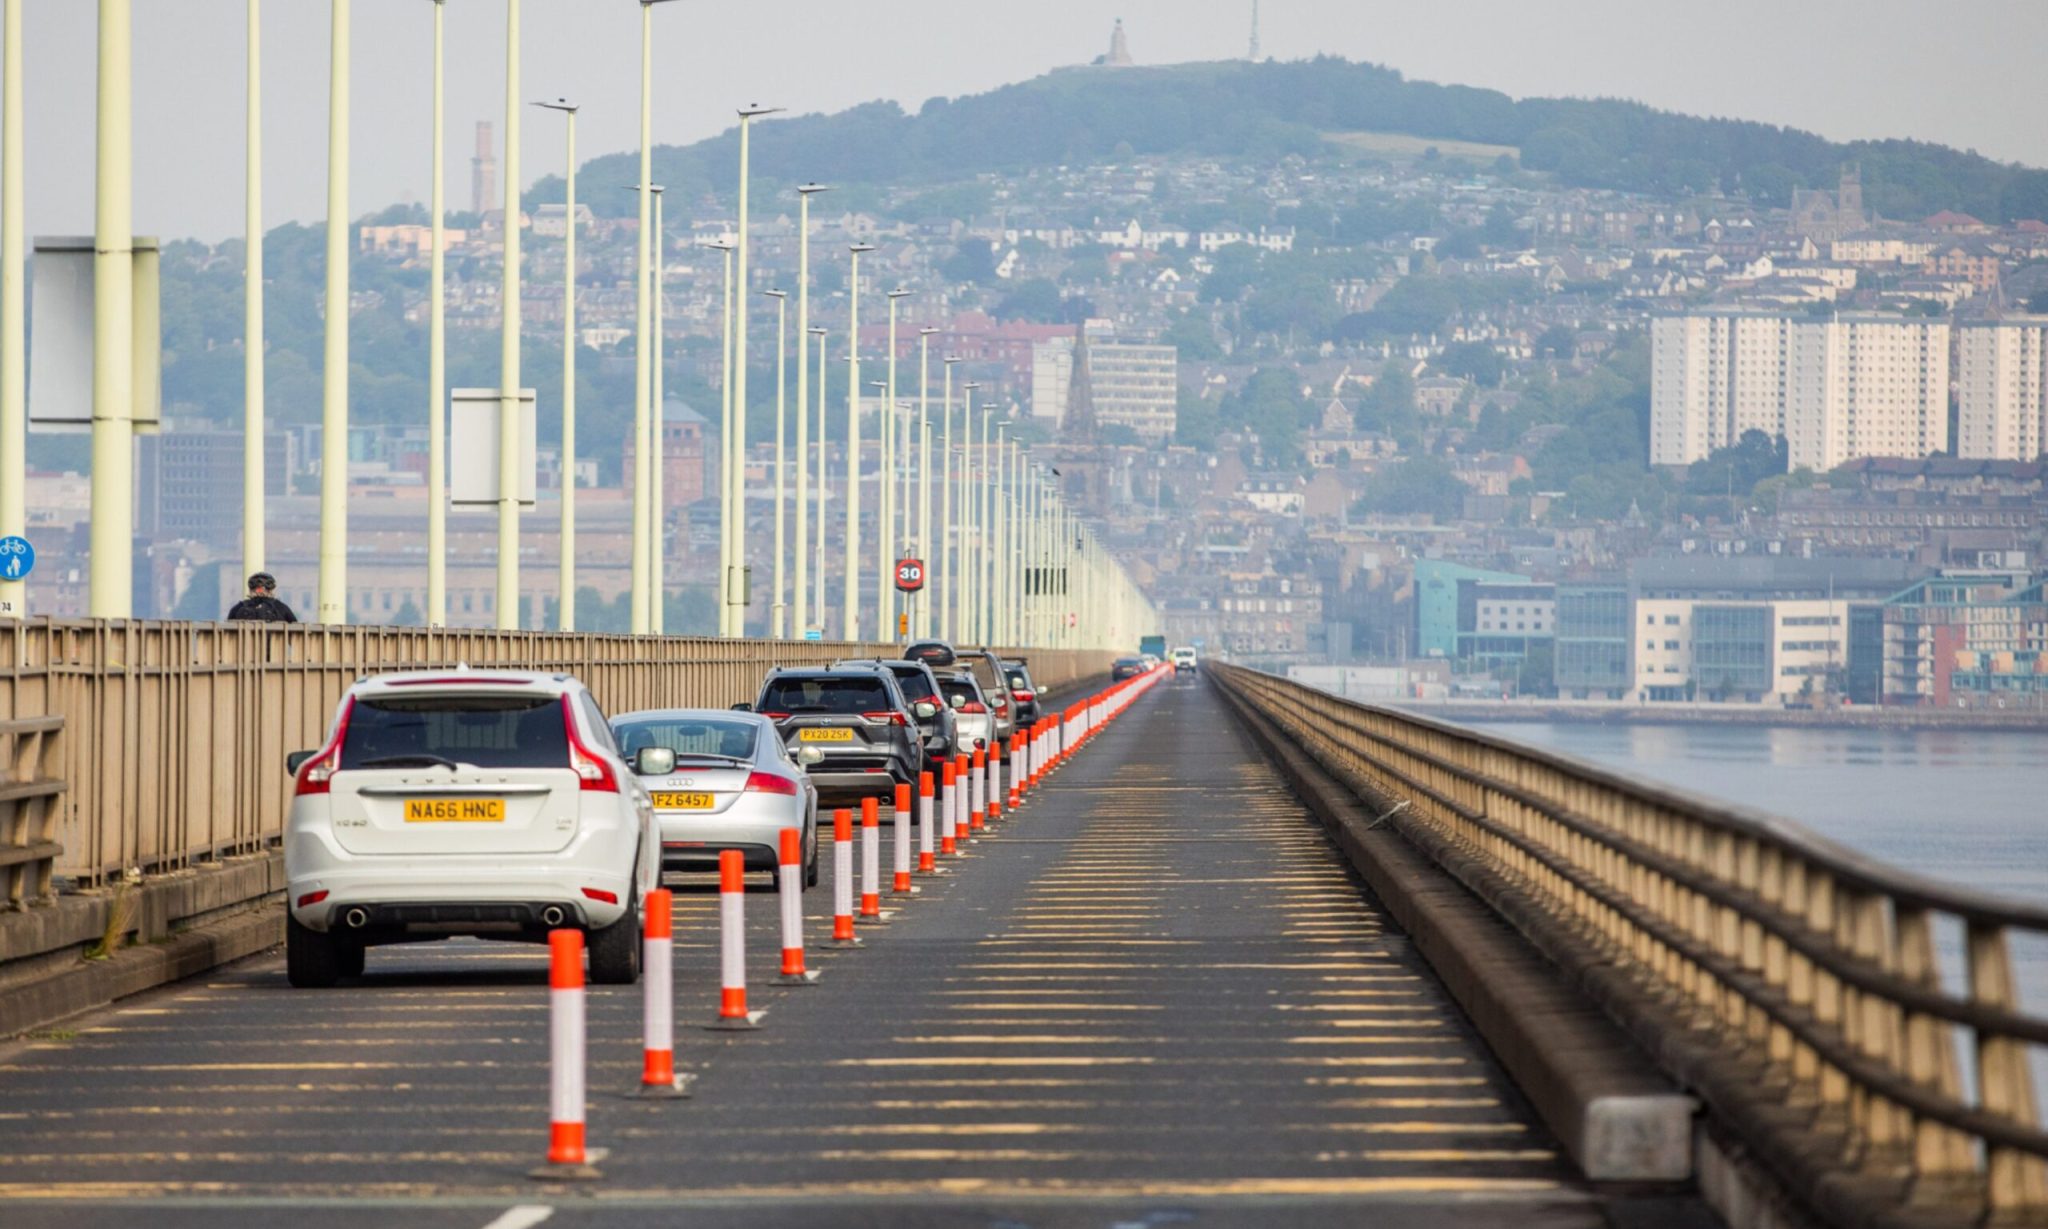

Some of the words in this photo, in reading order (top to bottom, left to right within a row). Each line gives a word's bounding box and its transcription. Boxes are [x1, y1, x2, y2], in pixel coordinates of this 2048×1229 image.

[899, 567, 920, 579] 30
[675, 794, 709, 806] 6457
[411, 802, 457, 818] NA66
[462, 802, 497, 818] HNC
